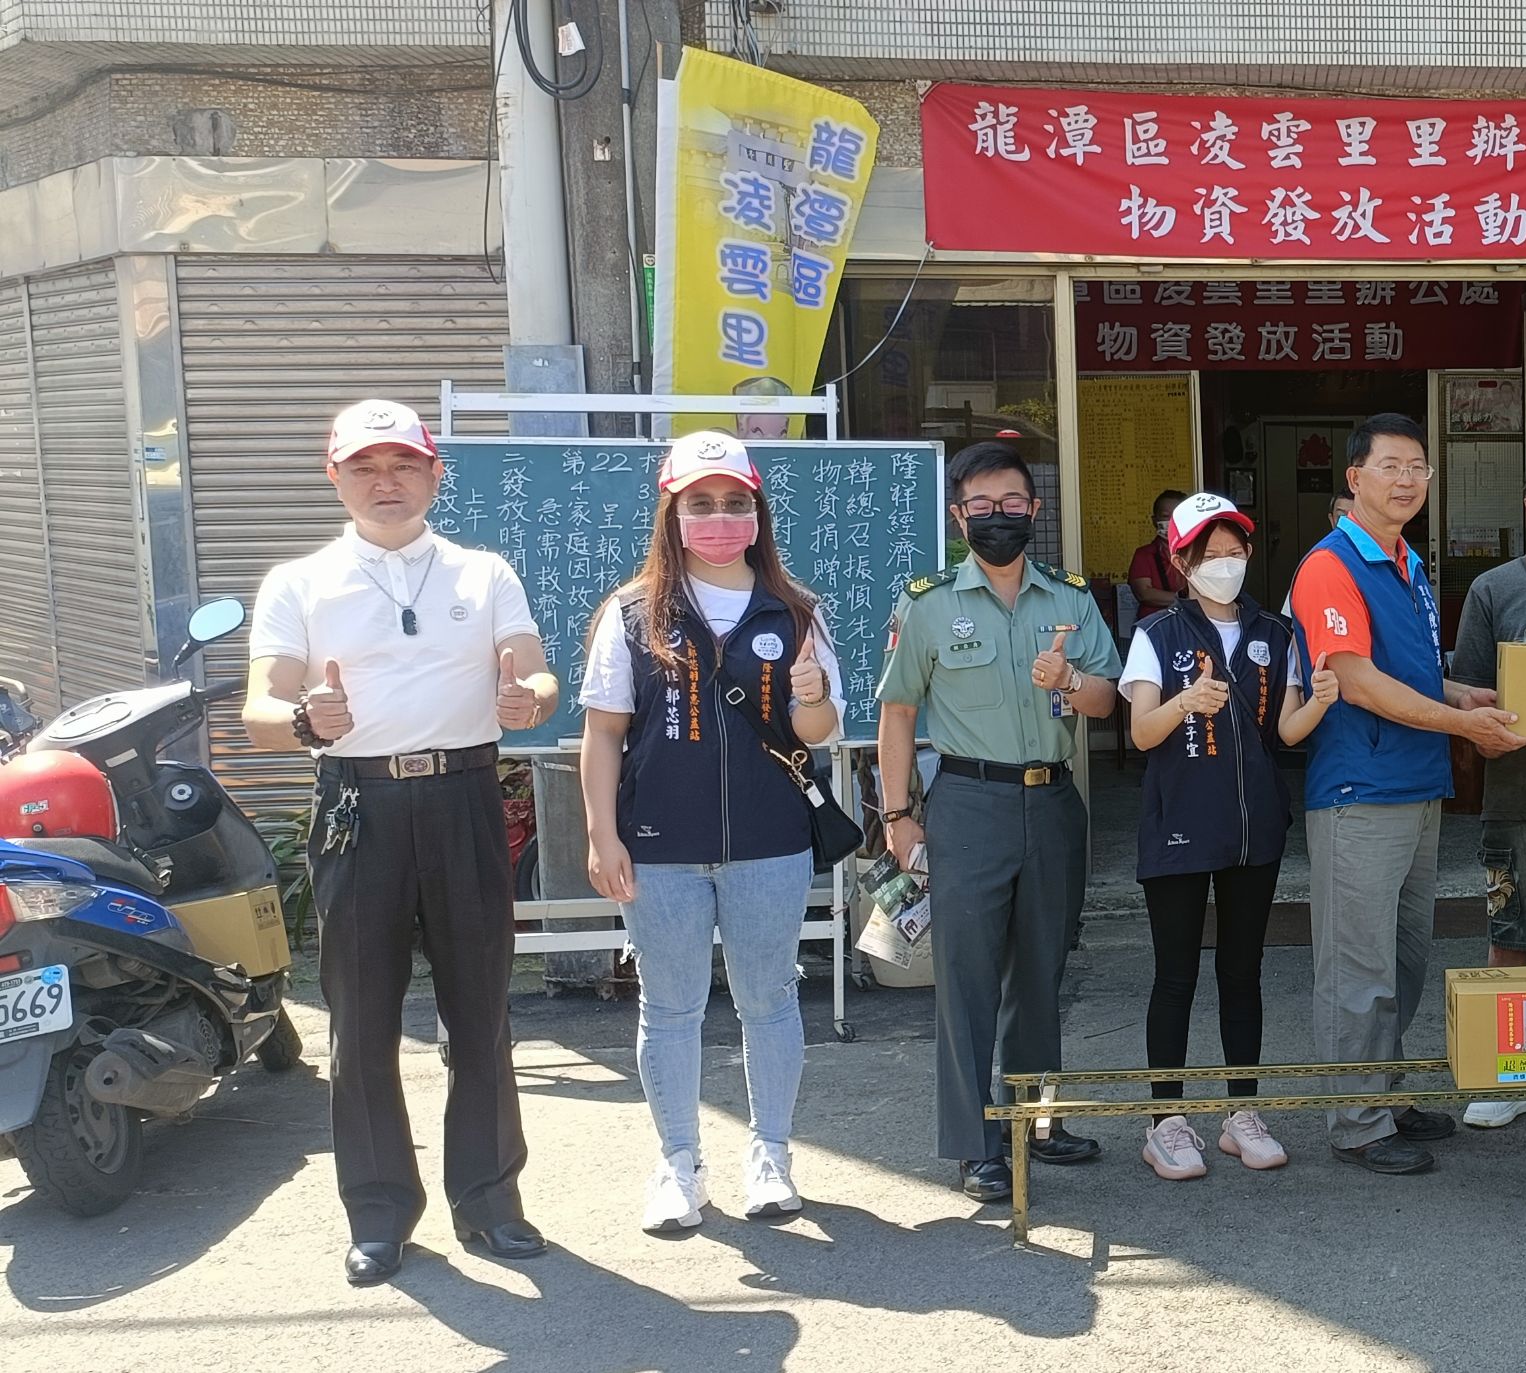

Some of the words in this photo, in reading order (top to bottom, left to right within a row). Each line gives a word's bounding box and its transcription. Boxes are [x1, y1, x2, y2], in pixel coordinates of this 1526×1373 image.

[792, 119, 865, 307] 龍潭區
[720, 173, 775, 367] 凌雲里
[1074, 281, 1500, 305] 區凌雲里里辦公處
[1096, 321, 1404, 362] 物資發放活動
[591, 452, 632, 472] 22
